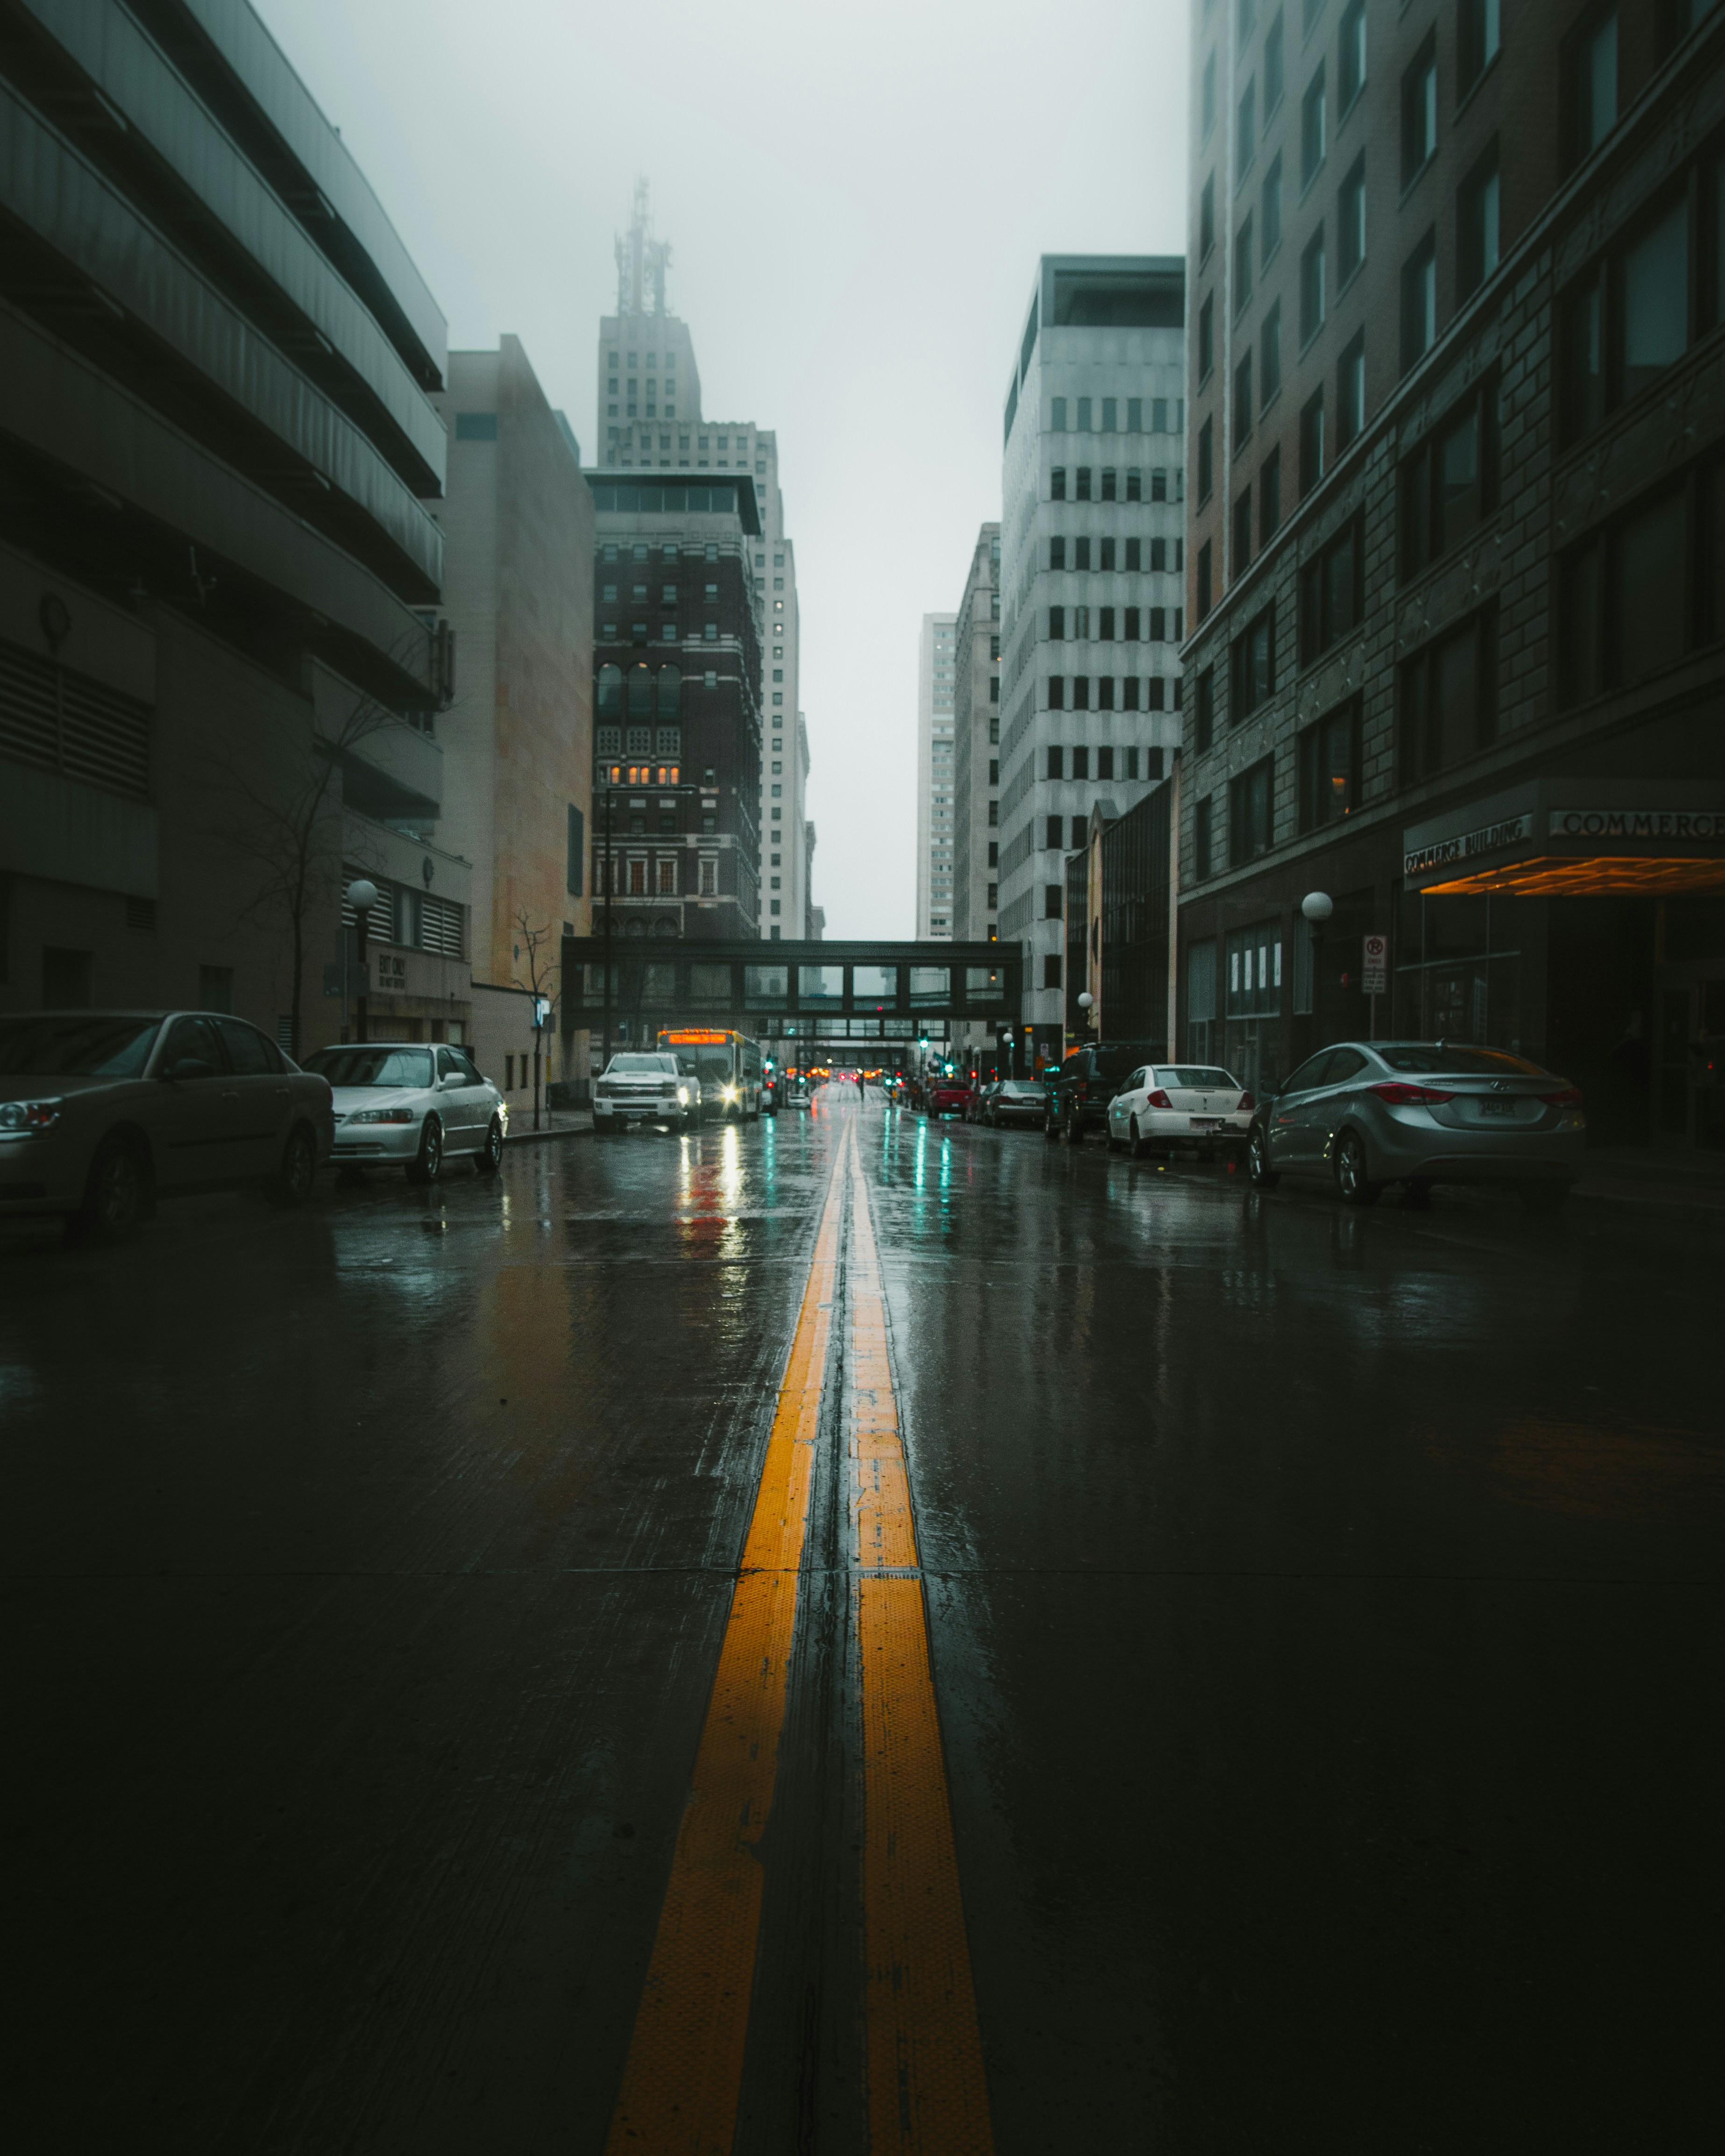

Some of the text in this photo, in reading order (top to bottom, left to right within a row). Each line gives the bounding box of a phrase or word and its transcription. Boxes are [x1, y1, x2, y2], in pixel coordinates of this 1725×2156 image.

[1563, 814, 1725, 837] COMMERCE
[1406, 819, 1523, 872] COMMERCE BUILDING
